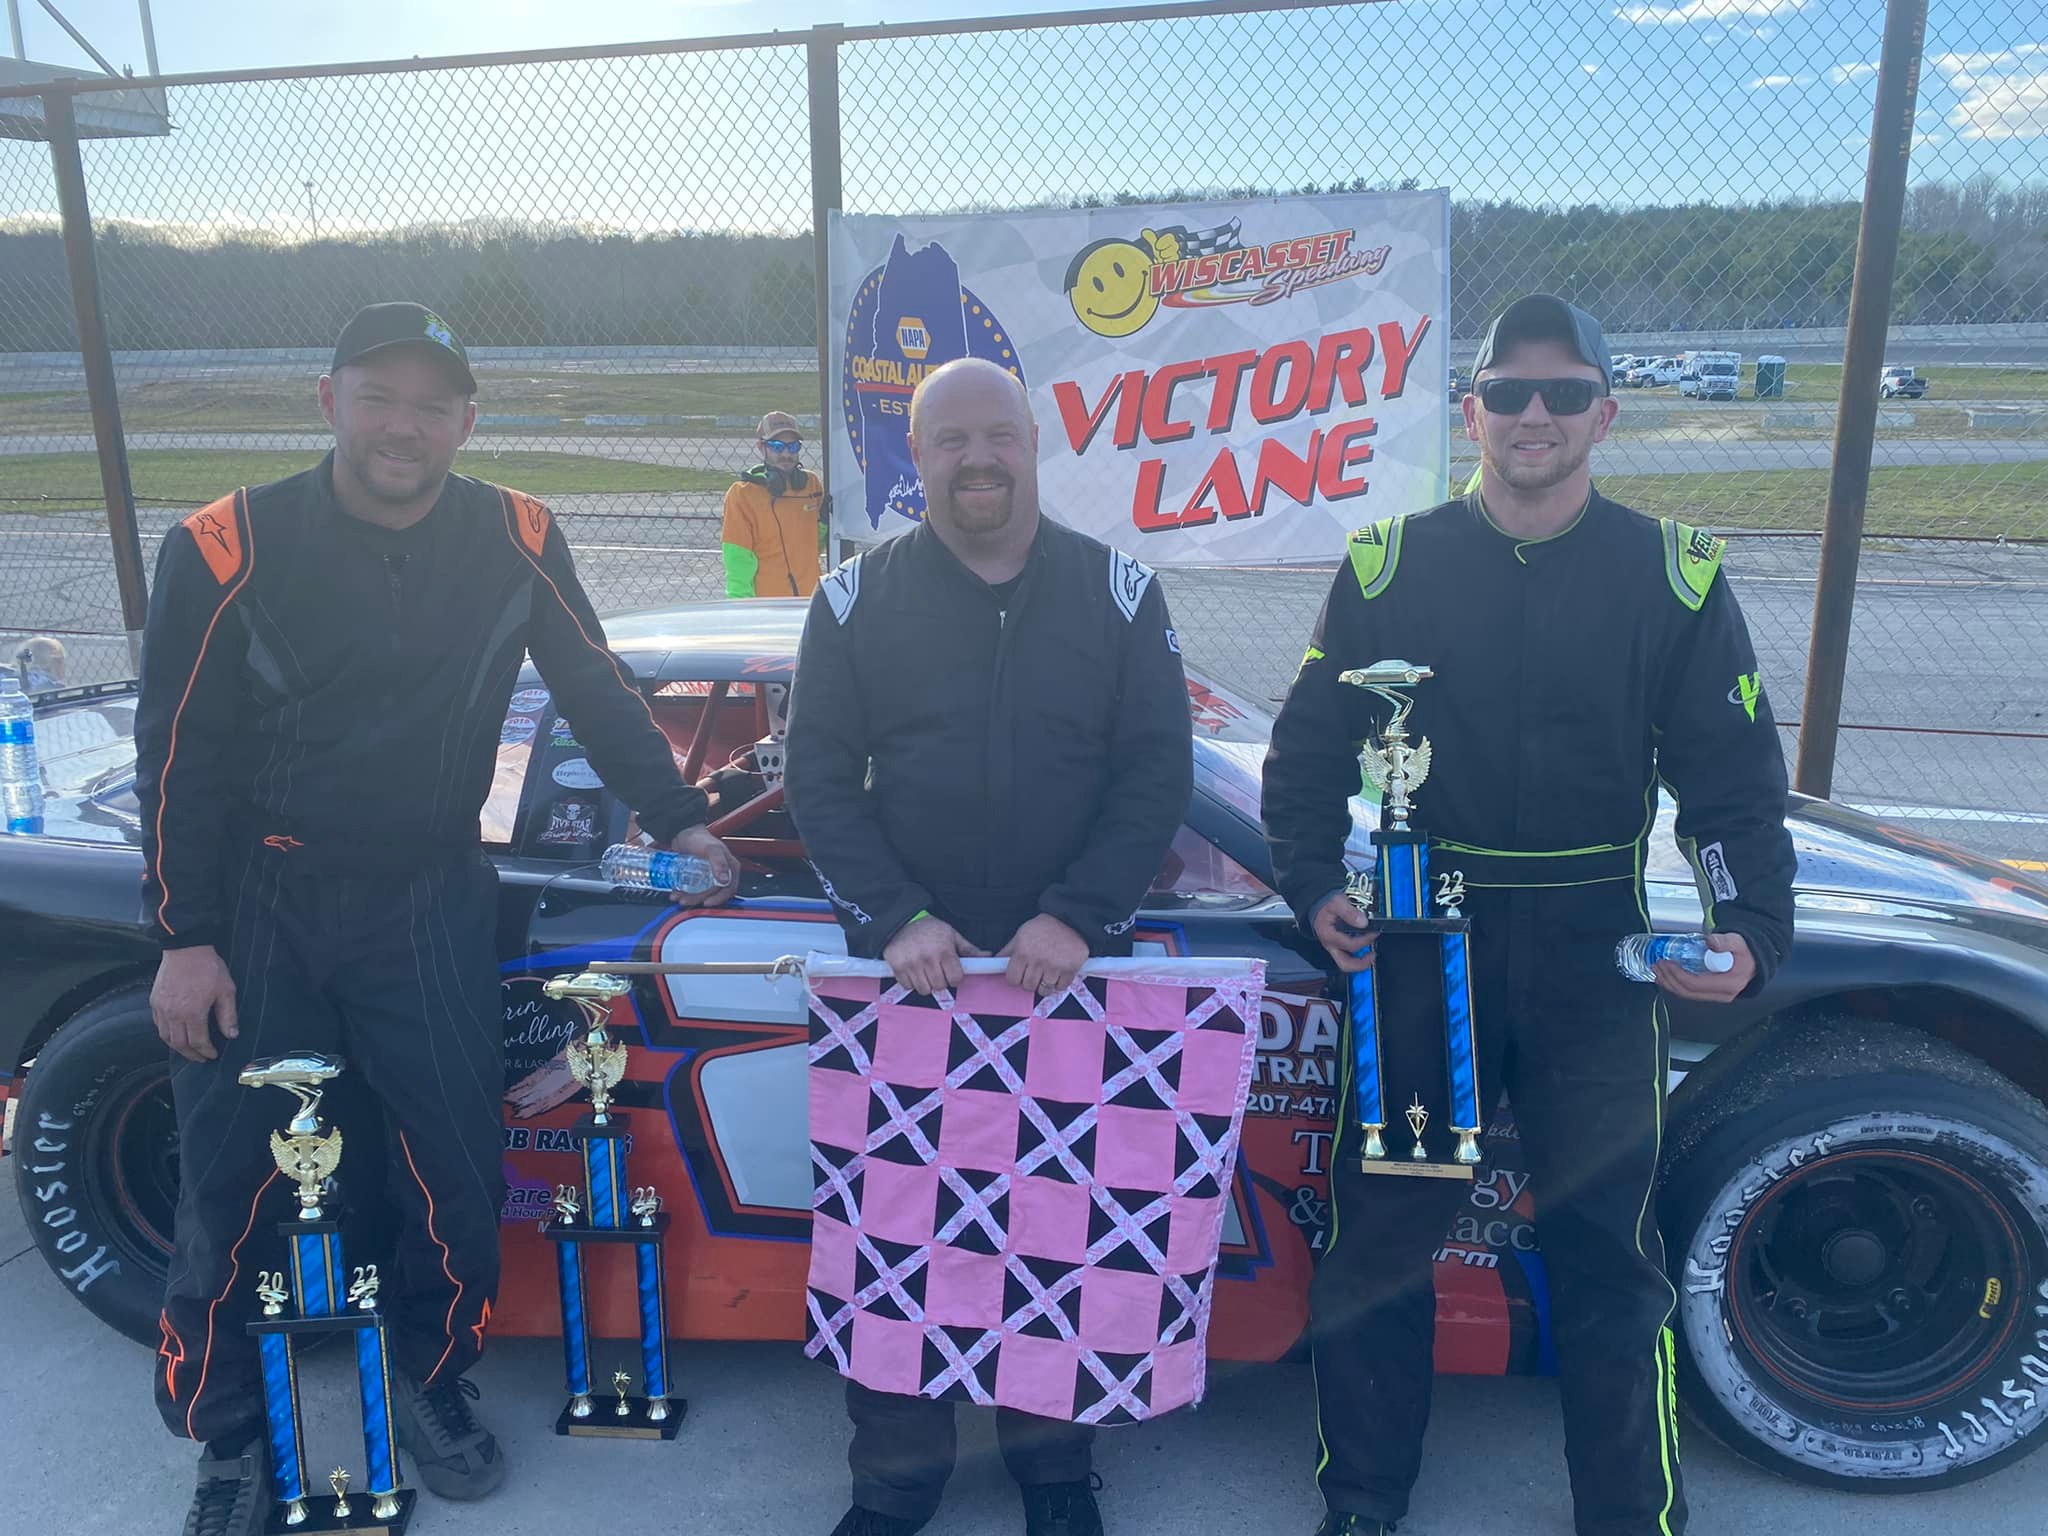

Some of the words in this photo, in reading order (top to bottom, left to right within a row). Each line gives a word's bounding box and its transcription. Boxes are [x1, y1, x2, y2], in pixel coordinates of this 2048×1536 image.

[1149, 228, 1355, 297] WISCASSET
[1249, 244, 1392, 306] Speedway
[901, 327, 926, 349] NAPA
[852, 355, 905, 387] COASTAL
[1052, 314, 1432, 456] VICTORY
[1132, 417, 1378, 533] LANE
[1438, 870, 1466, 895] 22
[22, 1111, 122, 1293] Hoosier
[1685, 1134, 1835, 1301] Hoosier
[256, 1271, 283, 1293] 20
